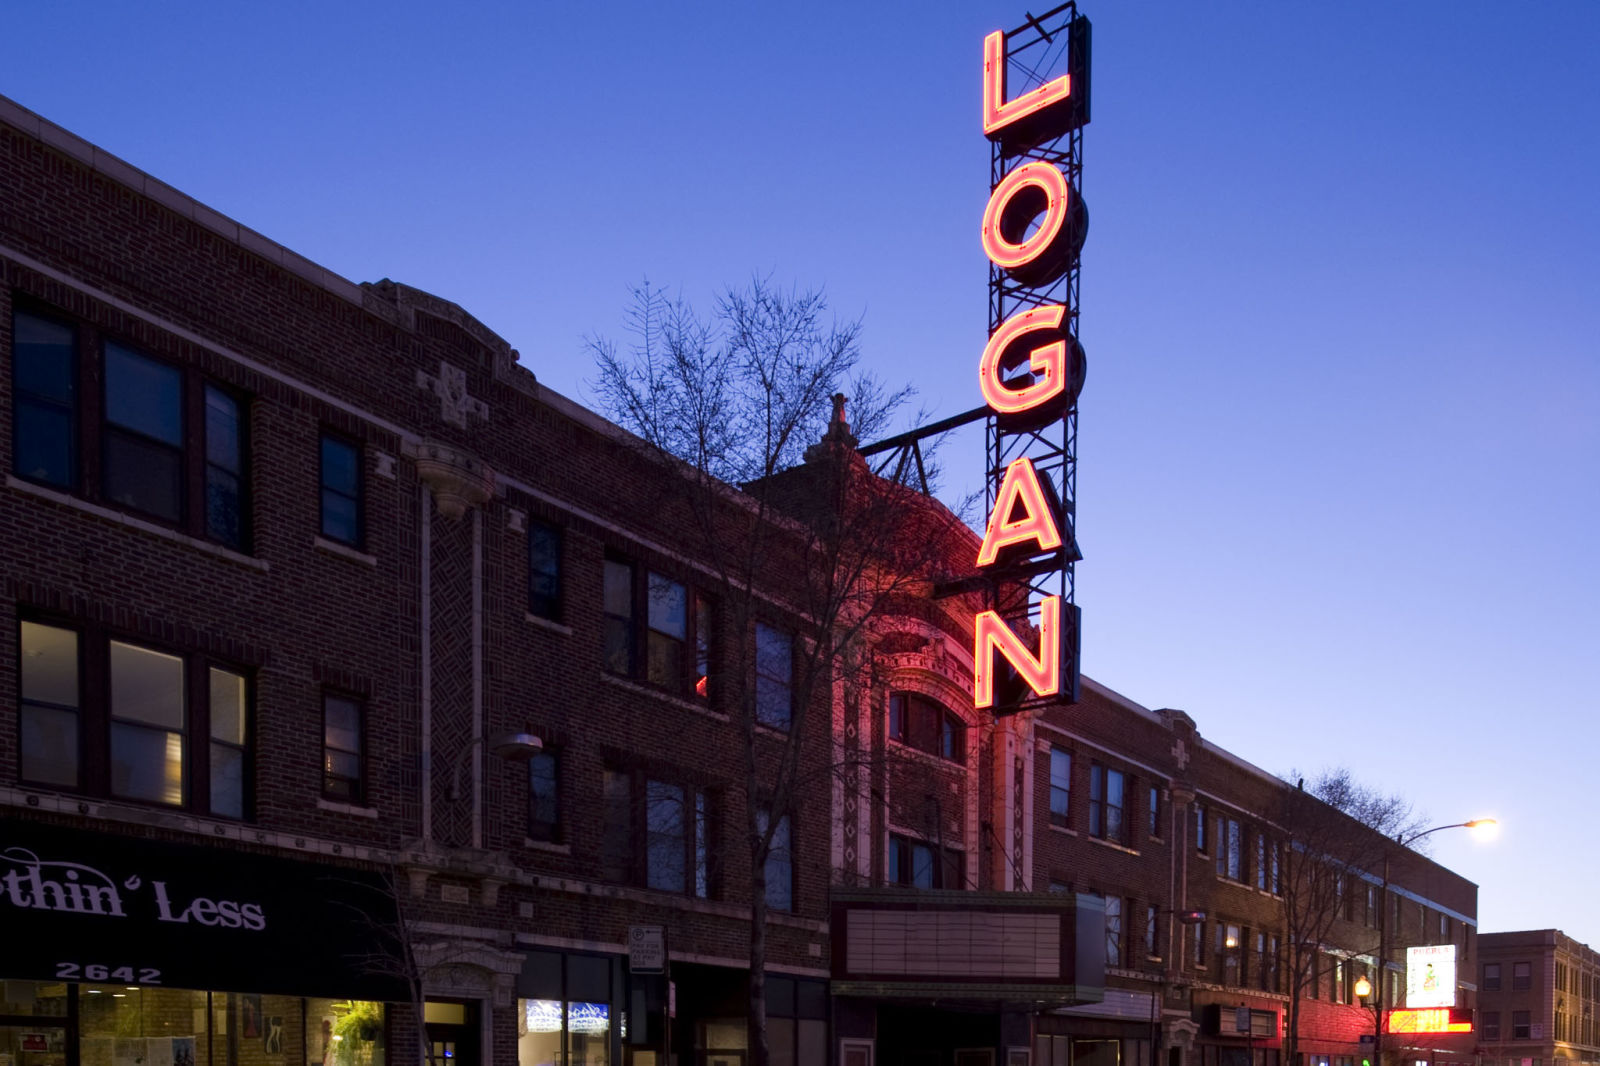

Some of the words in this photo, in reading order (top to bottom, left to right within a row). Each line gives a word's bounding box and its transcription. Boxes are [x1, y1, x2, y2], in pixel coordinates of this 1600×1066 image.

[974, 29, 1071, 709] LOGAN
[152, 880, 266, 931] Less
[56, 962, 161, 984] 2642
